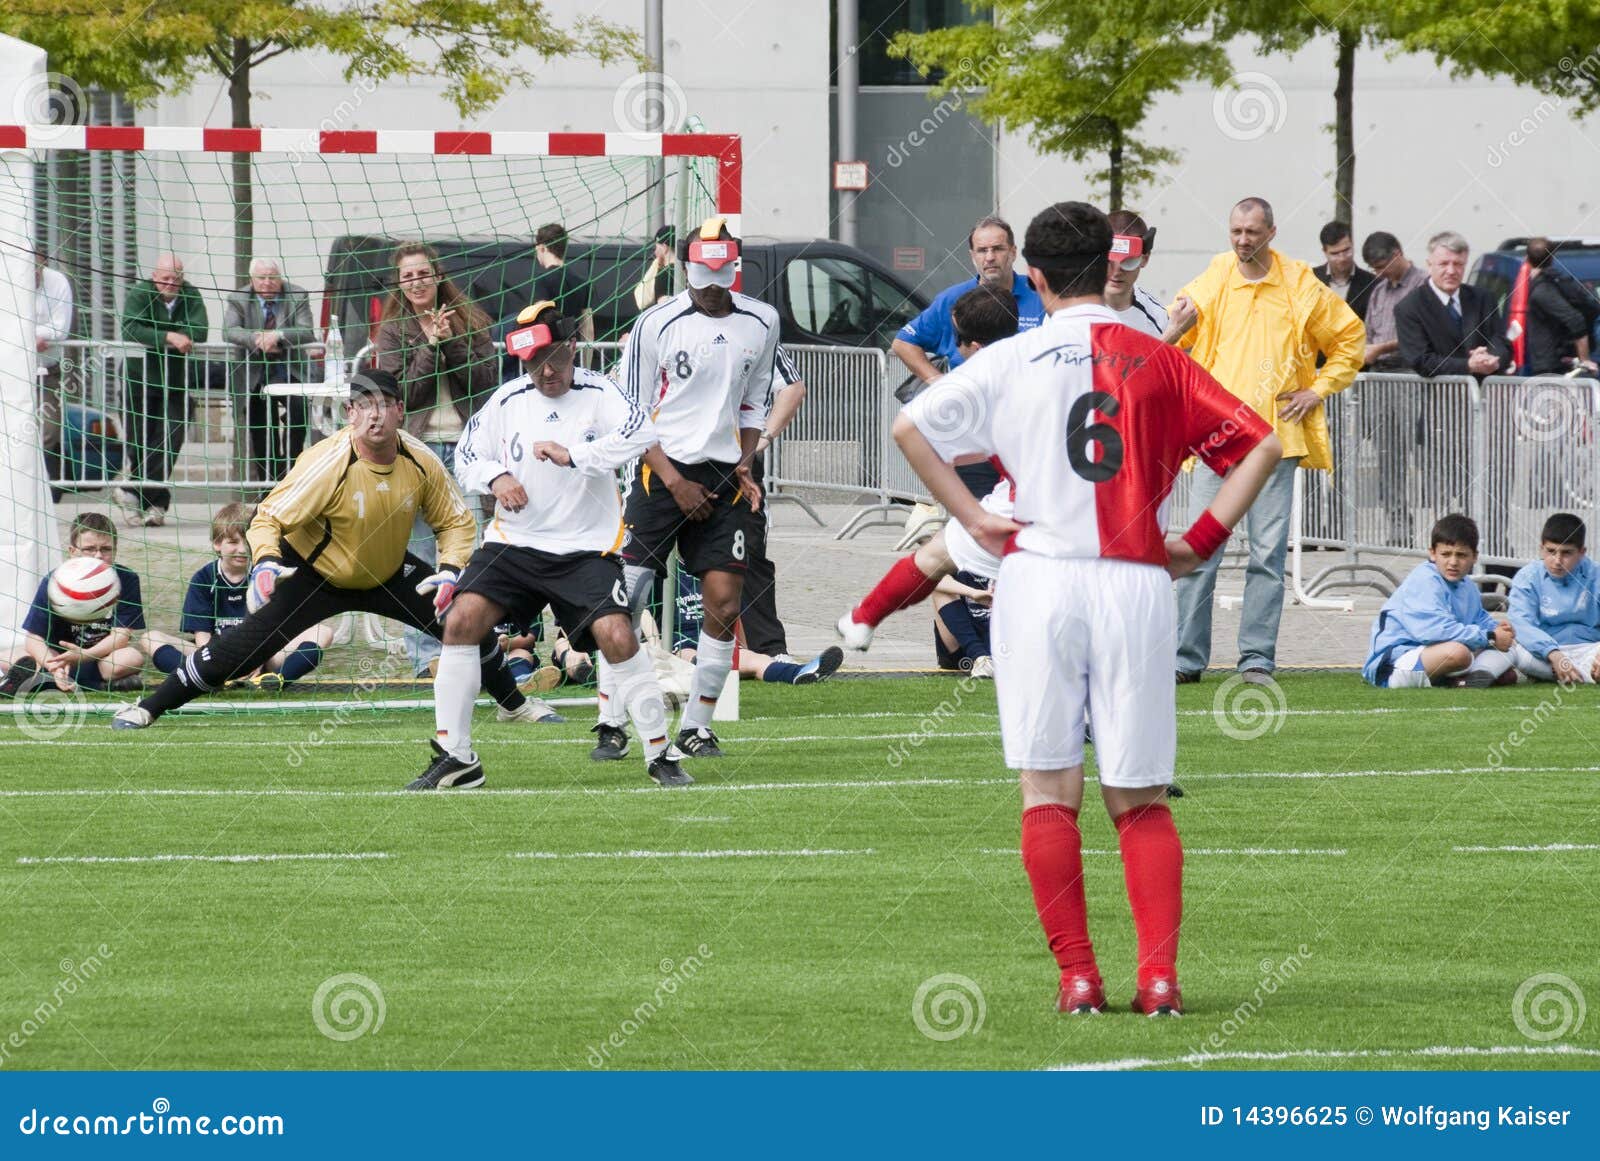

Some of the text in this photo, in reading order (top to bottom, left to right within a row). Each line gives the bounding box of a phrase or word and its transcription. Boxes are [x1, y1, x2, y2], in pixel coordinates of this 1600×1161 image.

[675, 350, 693, 379] 8
[1029, 343, 1147, 379] Türkiye
[510, 431, 524, 462] 6
[1066, 391, 1124, 483] 6
[352, 490, 365, 519] 1
[732, 529, 745, 560] 8
[612, 579, 628, 607] 6
